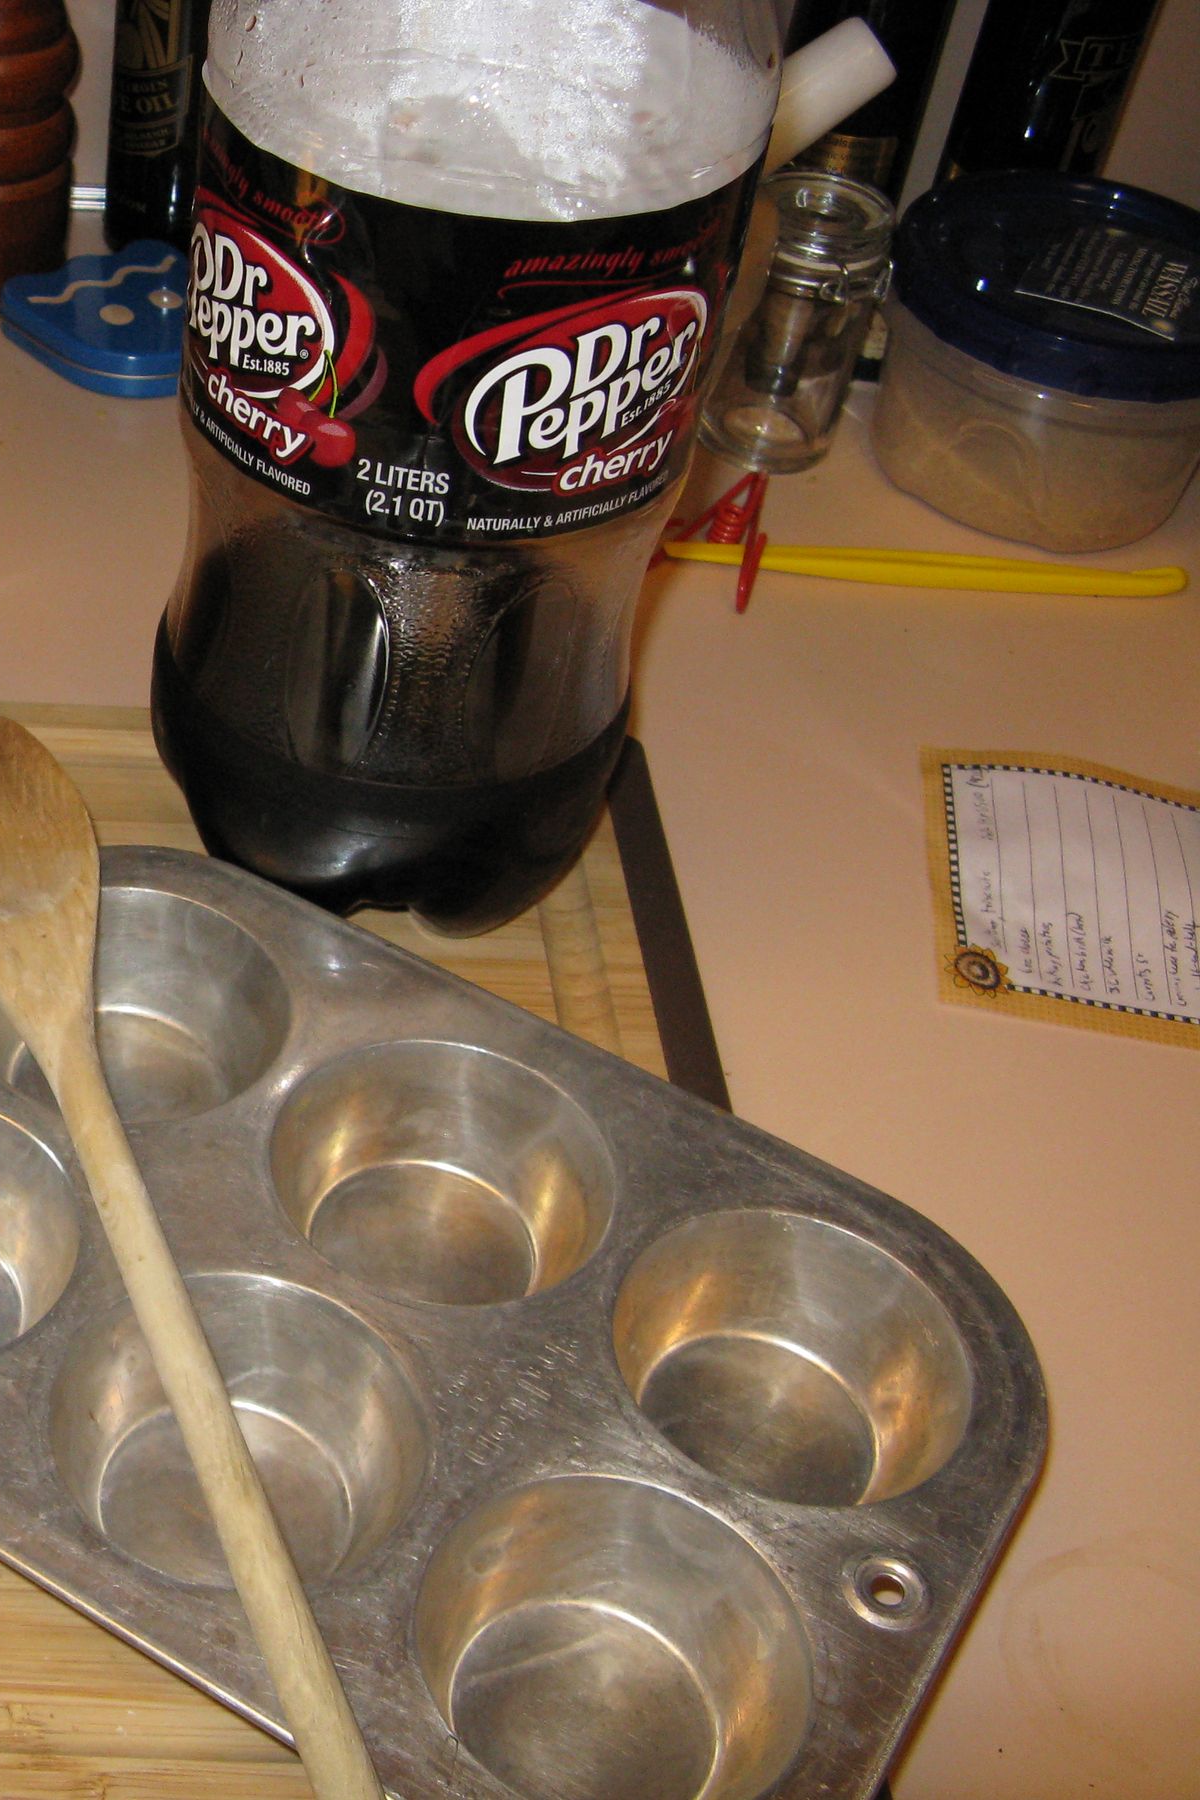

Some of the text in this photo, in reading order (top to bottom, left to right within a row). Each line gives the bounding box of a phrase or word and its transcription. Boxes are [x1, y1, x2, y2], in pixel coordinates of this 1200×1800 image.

[212, 234, 268, 307] Dr
[503, 245, 645, 278] amazingly
[1141, 259, 1190, 321] WASSAIL
[570, 316, 662, 399] Dr
[207, 373, 307, 459] cherry
[464, 321, 698, 465] Pepper
[205, 416, 254, 467] ARTIFICIALLY
[256, 458, 311, 496] FLAVORED
[356, 458, 450, 495] 2 LITERS
[558, 429, 674, 491] cherry
[365, 488, 445, 527] (2.1 QT)
[466, 515, 542, 532] NATURALLY
[542, 514, 554, 527] &
[555, 494, 627, 527] ARTIFICIALLY
